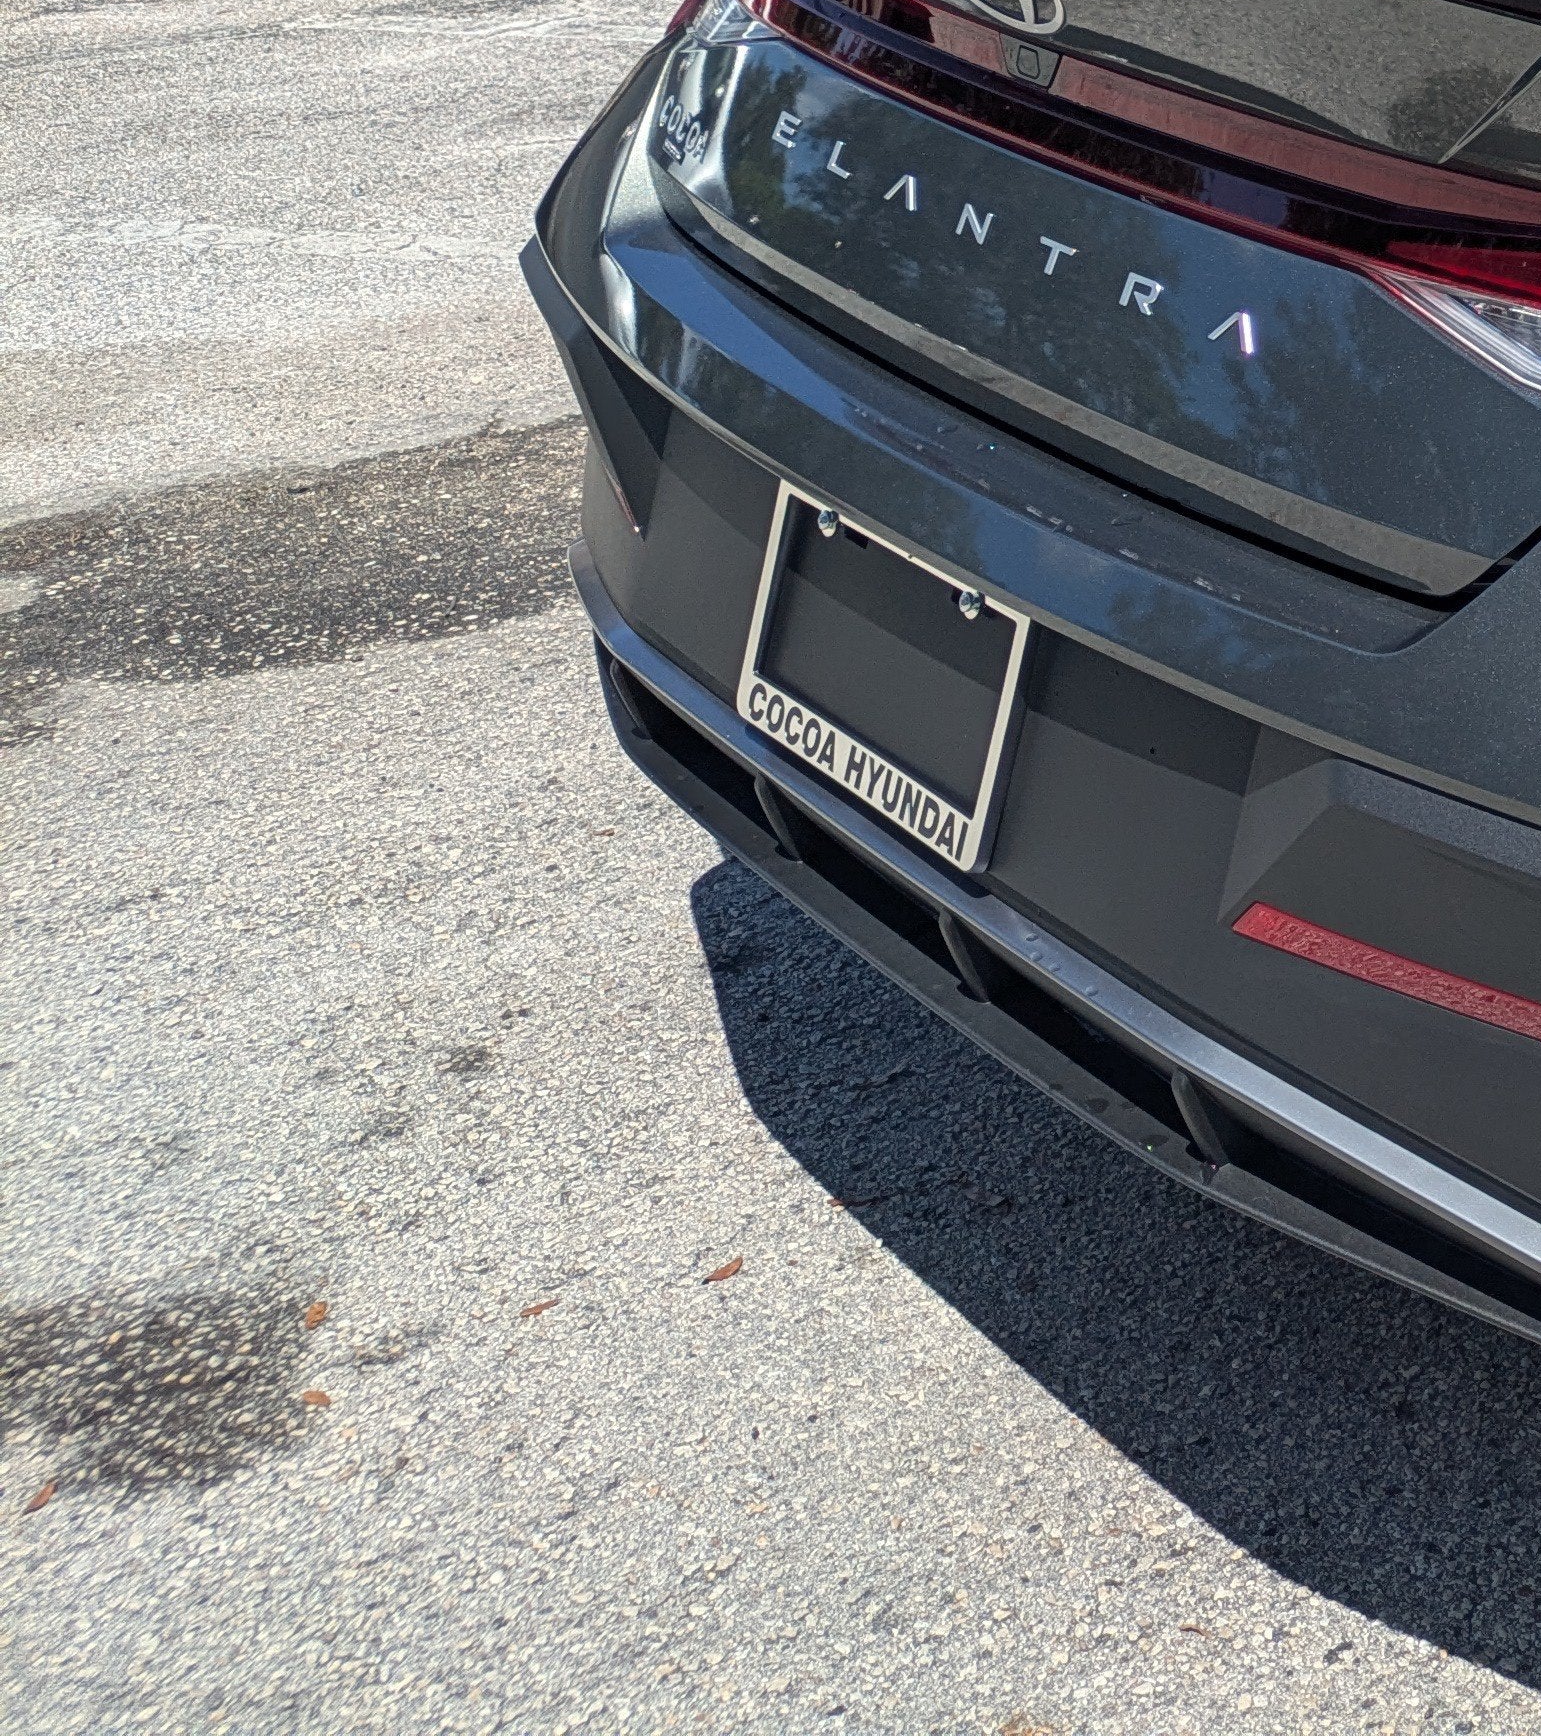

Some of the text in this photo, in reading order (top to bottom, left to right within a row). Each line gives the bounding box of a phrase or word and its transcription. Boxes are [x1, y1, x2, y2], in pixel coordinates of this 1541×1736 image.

[659, 95, 709, 164] COCOA
[770, 110, 1254, 356] ELANTRA
[748, 682, 970, 862] COCOA HYUNDAI
